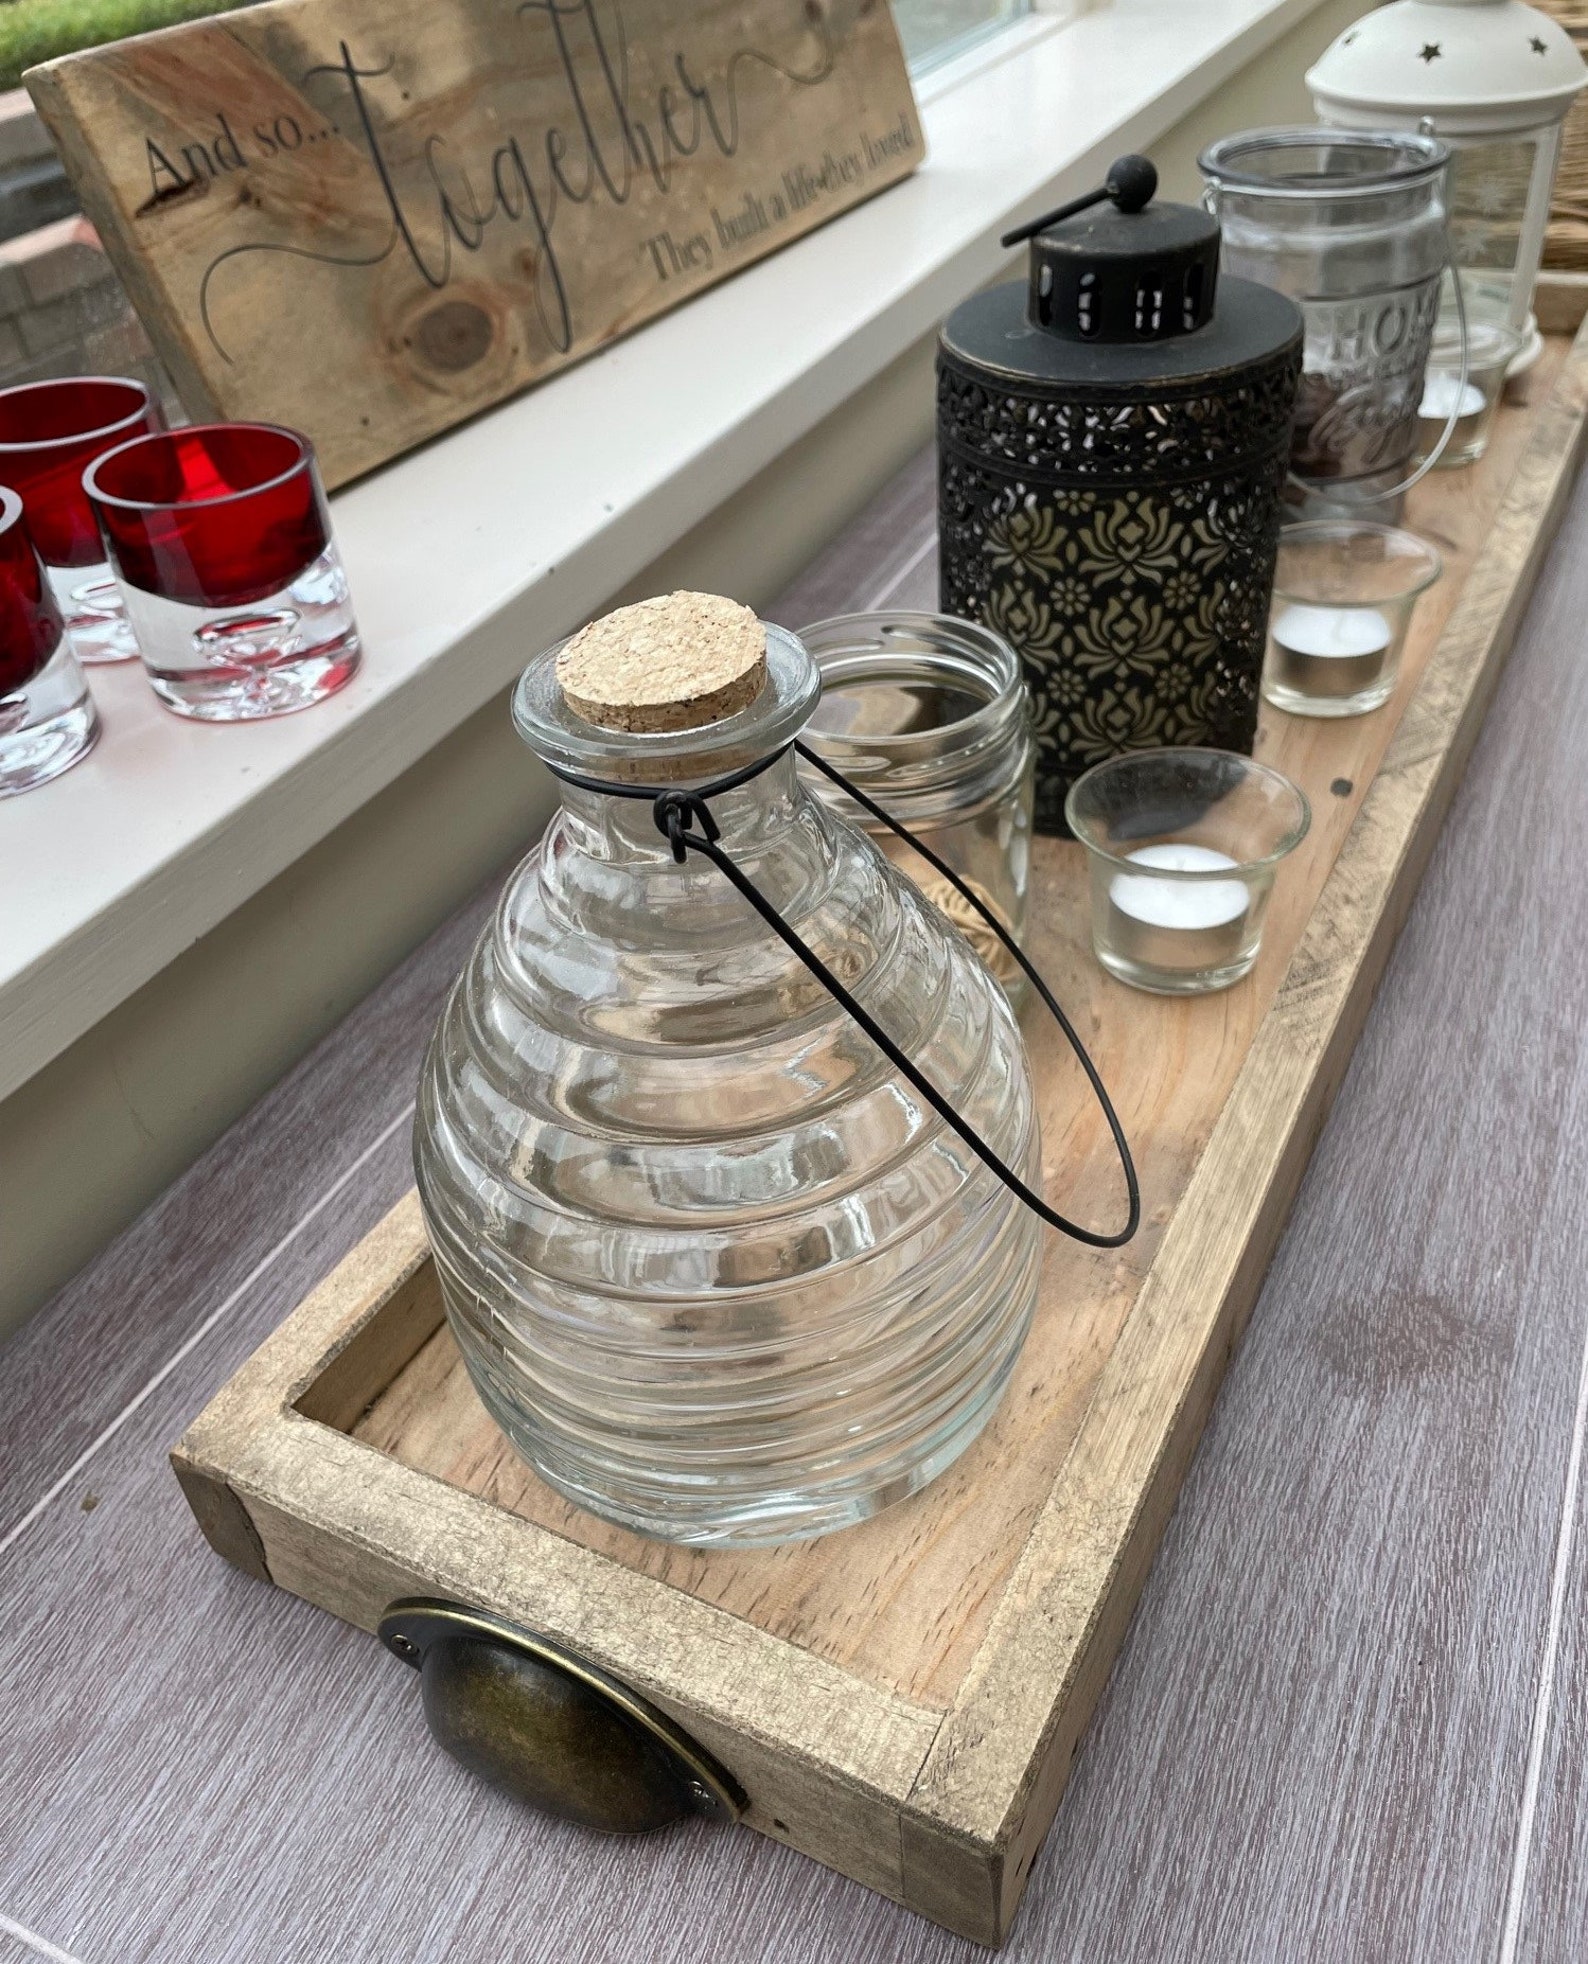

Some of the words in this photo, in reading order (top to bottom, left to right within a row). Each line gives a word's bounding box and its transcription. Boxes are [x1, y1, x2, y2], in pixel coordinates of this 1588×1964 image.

[145, 112, 248, 195] And
[201, 0, 833, 366] together
[642, 231, 715, 281] They
[770, 191, 788, 222] a
